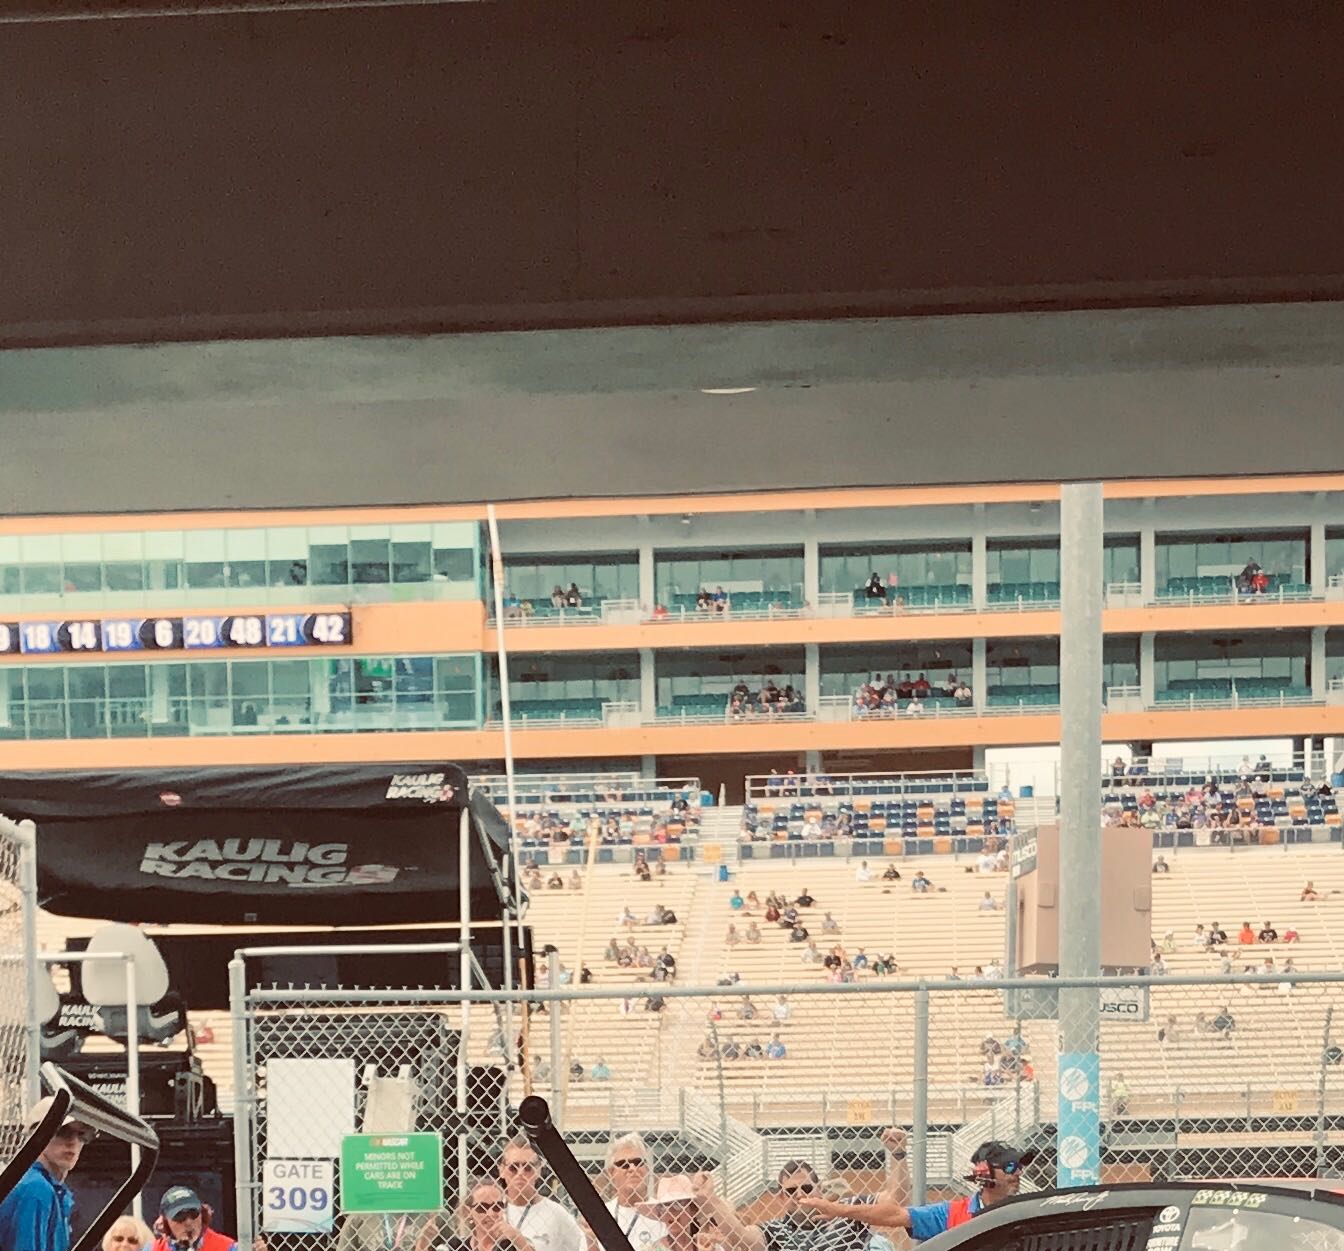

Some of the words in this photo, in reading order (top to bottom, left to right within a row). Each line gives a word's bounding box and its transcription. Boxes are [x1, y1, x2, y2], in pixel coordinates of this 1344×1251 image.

[24, 624, 50, 650] 18
[67, 622, 97, 649] 14
[106, 621, 133, 647] 19
[154, 619, 174, 647] 6
[187, 619, 215, 645] 20
[229, 616, 263, 645] 48
[270, 617, 297, 643] 21
[312, 614, 345, 642] 42
[390, 773, 445, 786] KAULIG
[385, 786, 442, 799] RACING
[143, 838, 349, 864] KAULIG
[139, 860, 350, 884] RACING
[364, 1152, 397, 1161] MINORS
[397, 1151, 416, 1160] NOT
[272, 1163, 324, 1180] GATE
[355, 1161, 398, 1171] PERMITTED
[400, 1160, 424, 1170] WHILE
[363, 1171, 385, 1180] CARS
[387, 1171, 401, 1180] ARE
[402, 1170, 417, 1179] ON
[377, 1180, 403, 1189] TRACK
[268, 1186, 329, 1212] 309
